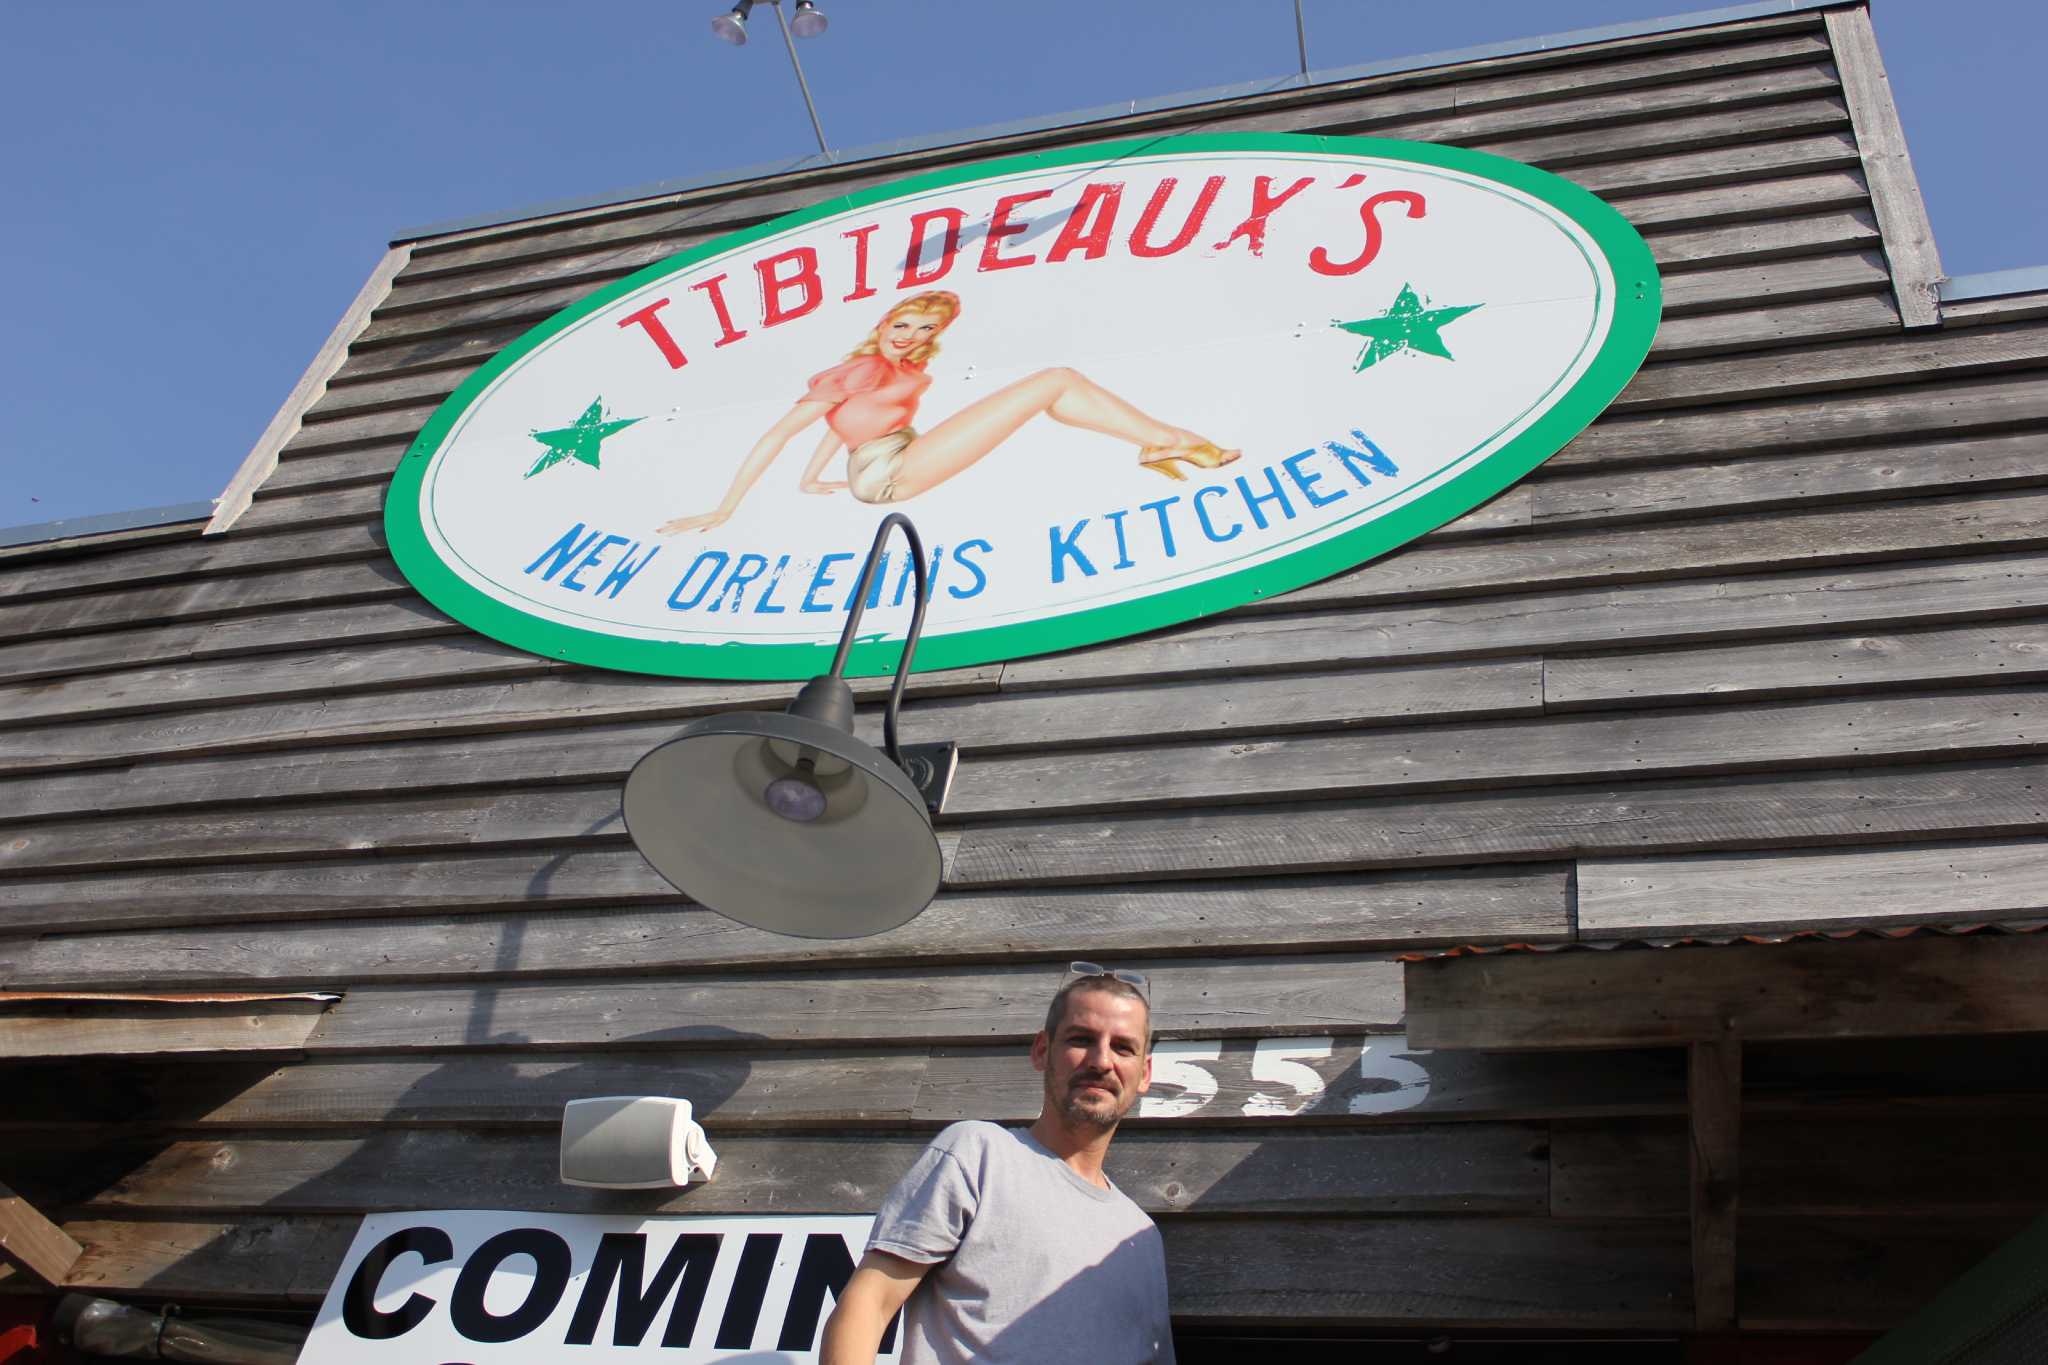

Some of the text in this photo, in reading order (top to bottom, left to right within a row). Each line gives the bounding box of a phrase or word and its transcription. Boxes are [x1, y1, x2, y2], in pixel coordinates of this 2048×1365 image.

[618, 173, 1427, 371] TIBIDEAUX'S
[524, 427, 1400, 615] NEW ORLEANS KITCHEN
